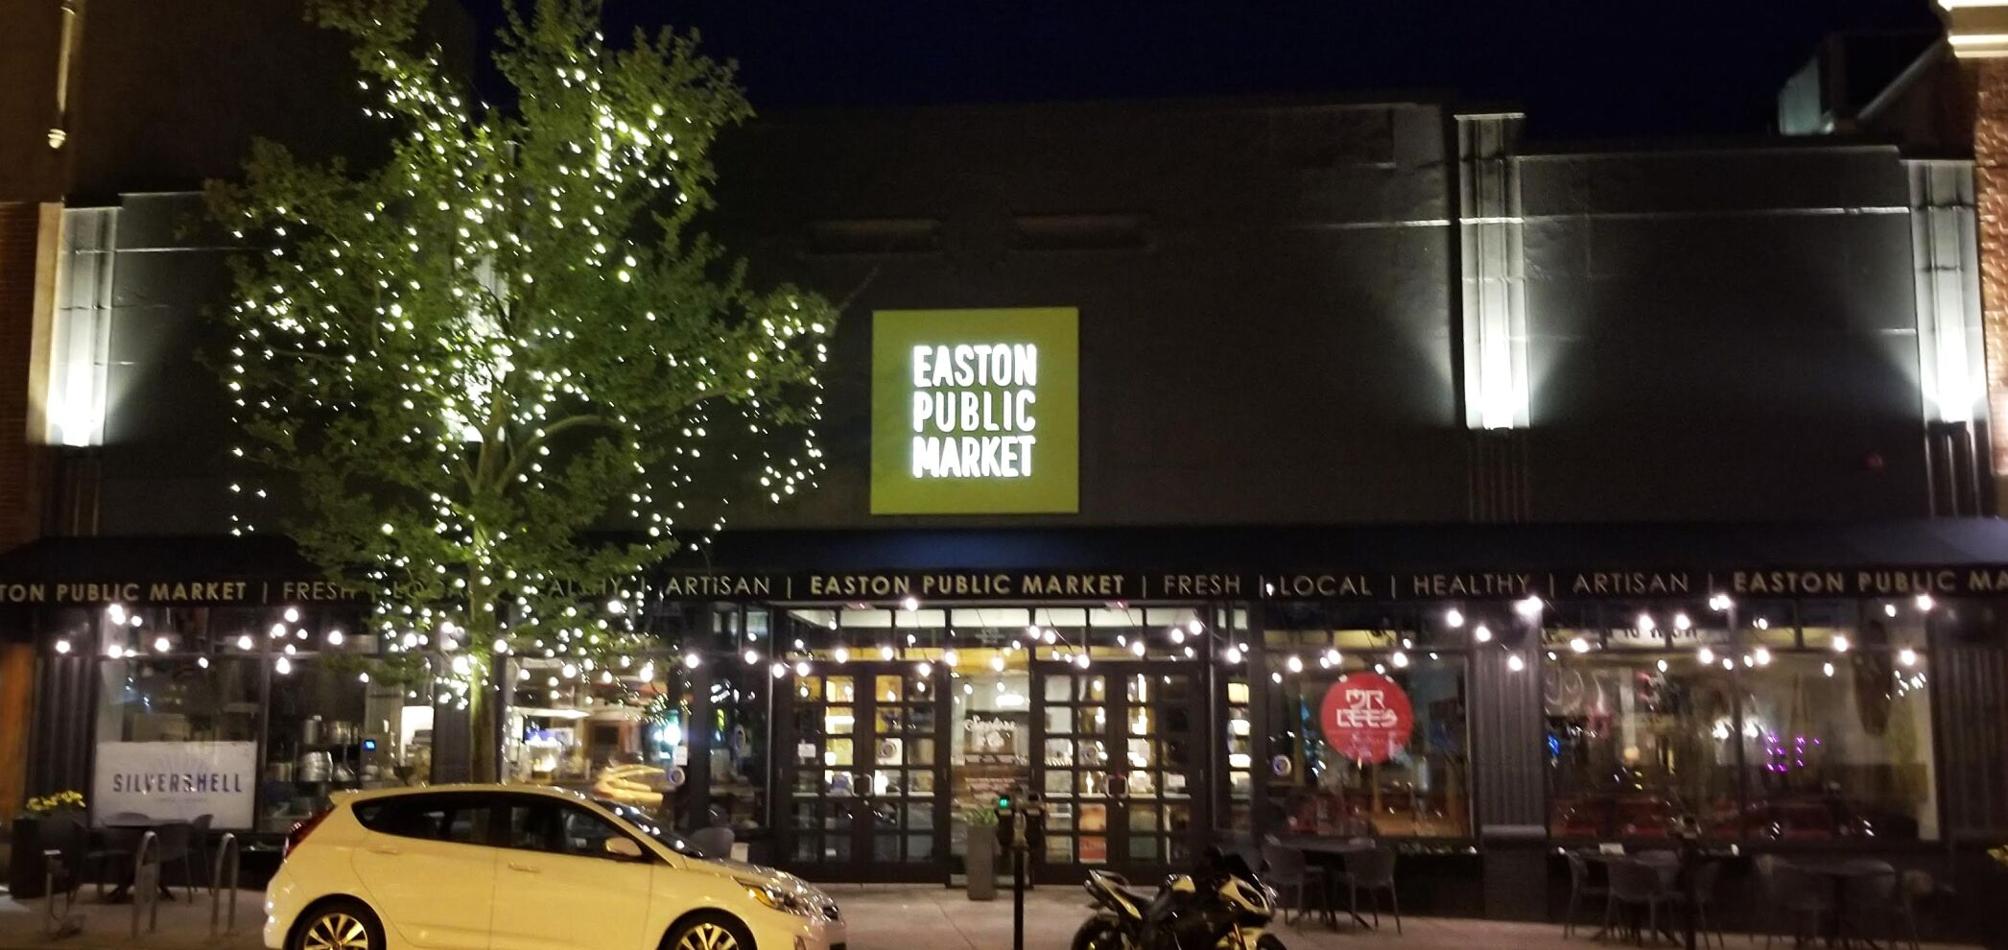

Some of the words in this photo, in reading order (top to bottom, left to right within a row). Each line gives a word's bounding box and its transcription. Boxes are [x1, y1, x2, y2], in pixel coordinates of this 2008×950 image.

[913, 343, 1038, 387] EASTON
[913, 389, 1036, 432] PUBLIC
[912, 435, 1036, 478] MARKET
[56, 583, 139, 601] PUBLIC
[150, 582, 247, 600] MARKET
[665, 576, 769, 596] ARTISAN
[811, 575, 910, 595] EASTON
[923, 575, 1010, 594] PUBLIC
[1022, 575, 1124, 594] MARKET
[1164, 575, 1241, 594] FRESH
[1280, 575, 1373, 595] LOCAL
[1413, 575, 1530, 595] HEALTHY
[1572, 573, 1688, 592] ARTISAN
[1733, 571, 1843, 592] EASTON
[1858, 571, 1955, 592] PUBLIC
[114, 773, 242, 793] SILVERSHELL
